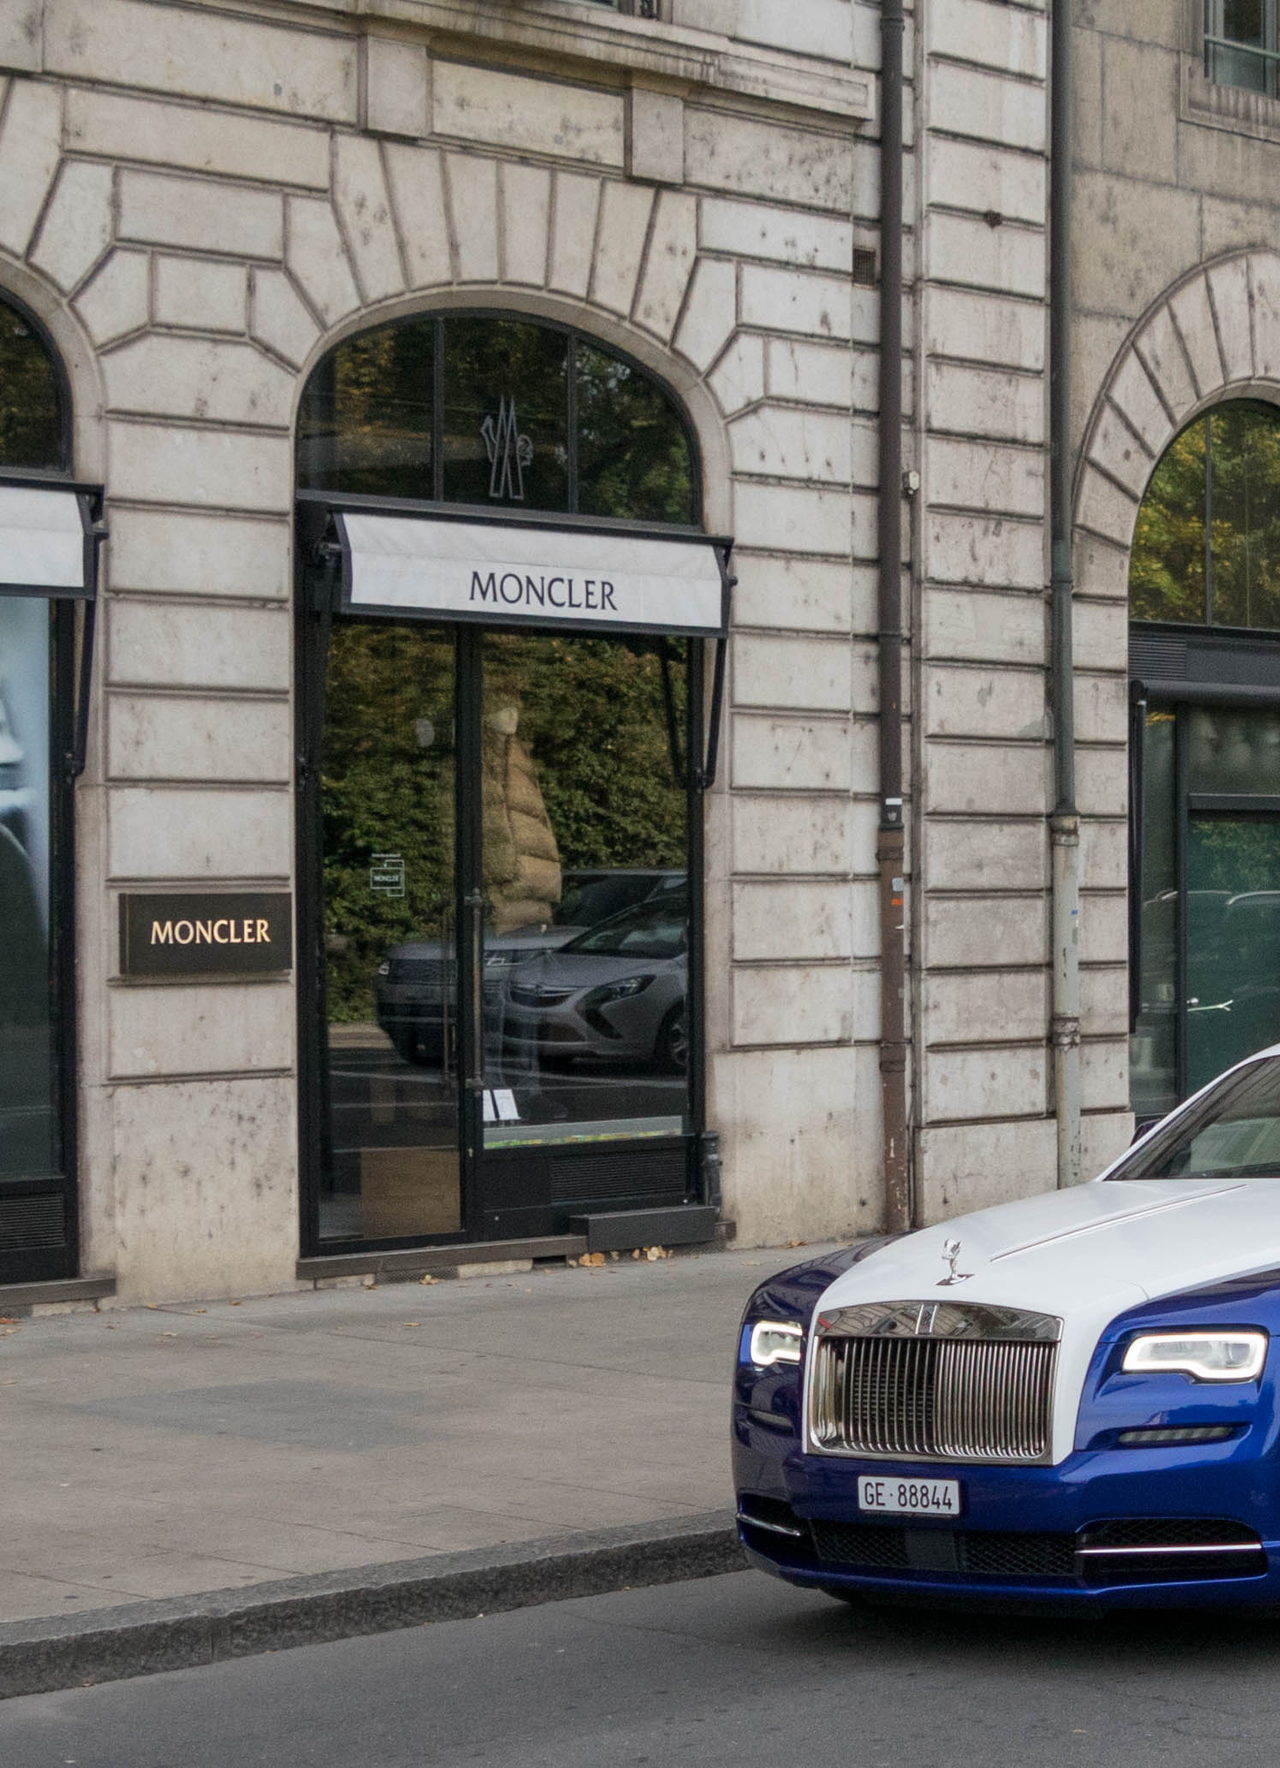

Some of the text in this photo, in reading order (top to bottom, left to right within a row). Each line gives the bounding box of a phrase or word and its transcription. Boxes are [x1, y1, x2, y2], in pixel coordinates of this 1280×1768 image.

[469, 571, 618, 611] MONCLER
[150, 919, 271, 945] MONCLER
[898, 1484, 952, 1509] 88844
